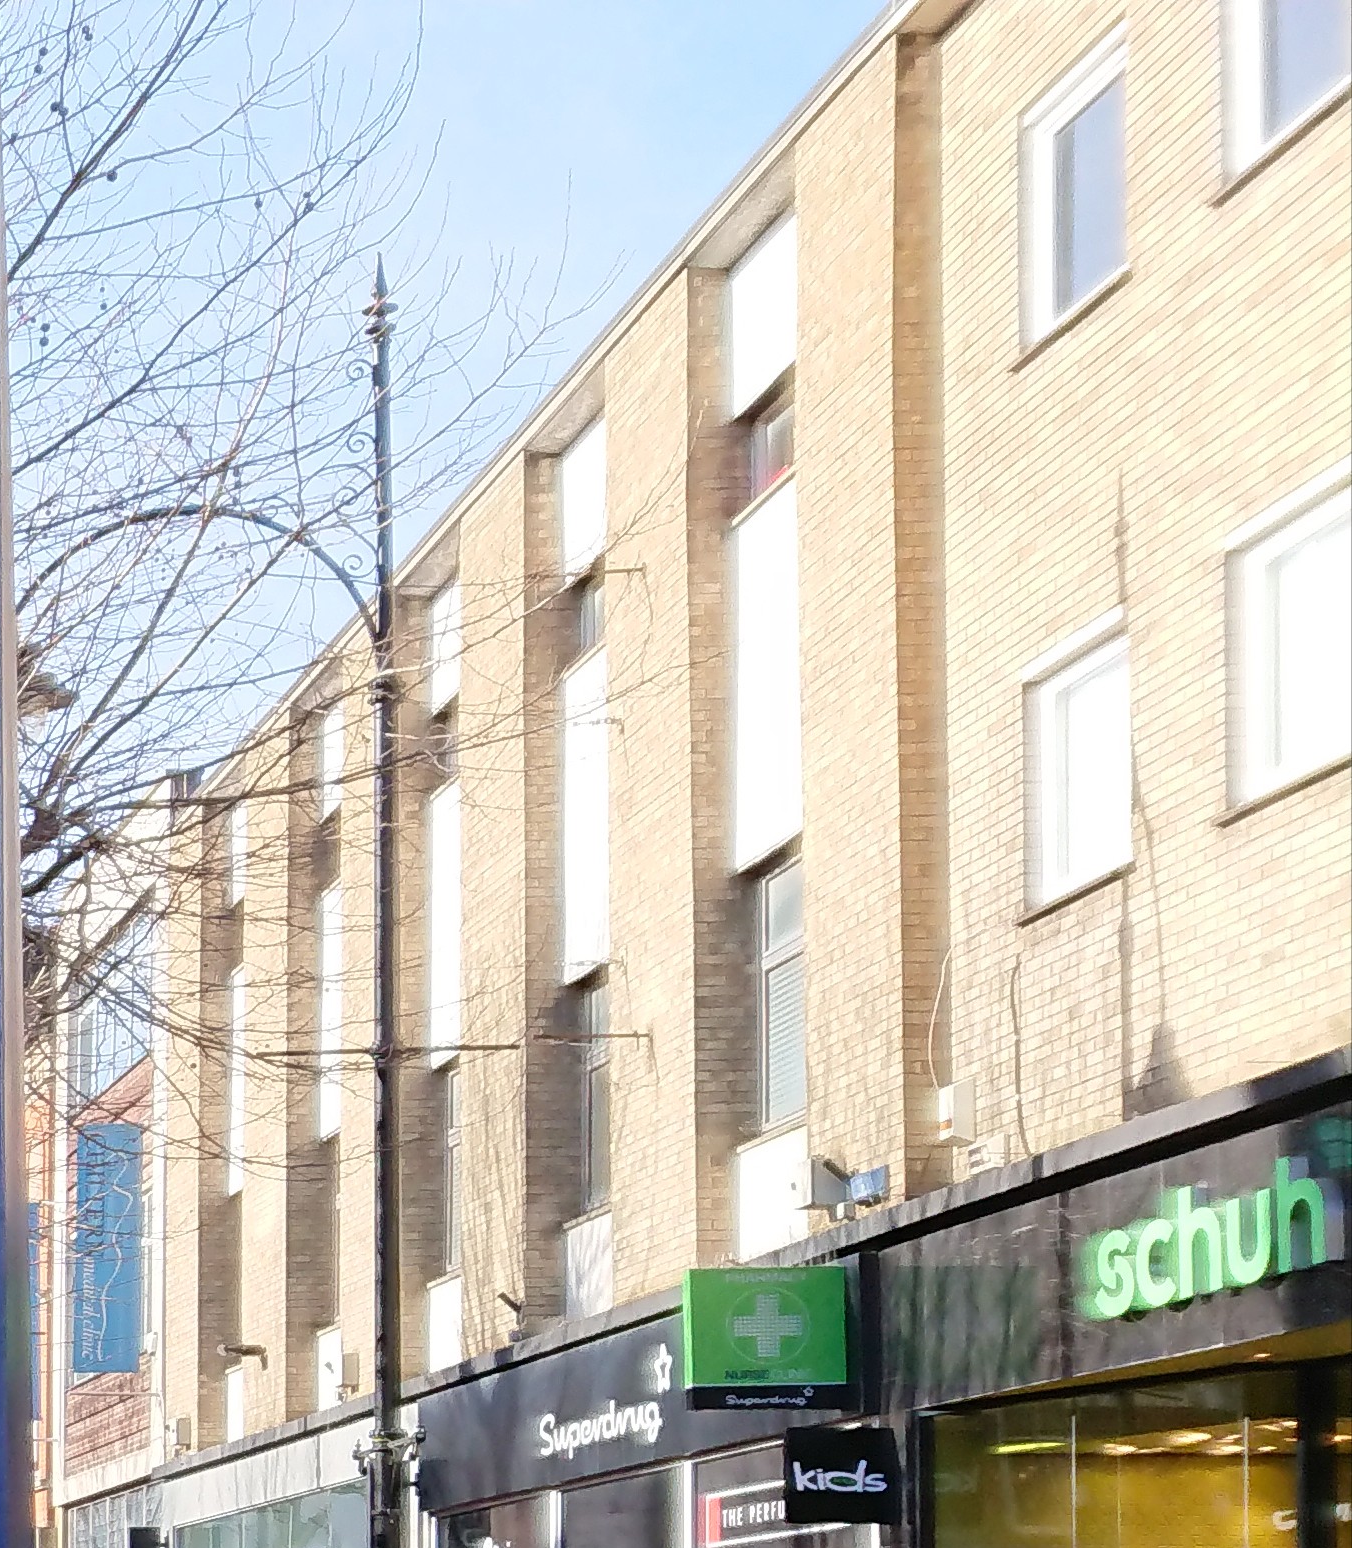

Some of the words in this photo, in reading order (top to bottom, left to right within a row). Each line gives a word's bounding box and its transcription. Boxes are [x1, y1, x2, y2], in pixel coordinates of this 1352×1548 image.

[1095, 1157, 1327, 1317] schuh
[725, 1394, 808, 1407] Superdrug
[539, 1399, 663, 1460] Superdrug
[792, 1459, 888, 1493] kids
[722, 1504, 743, 1528] THE
[749, 1499, 786, 1524] PERFU
